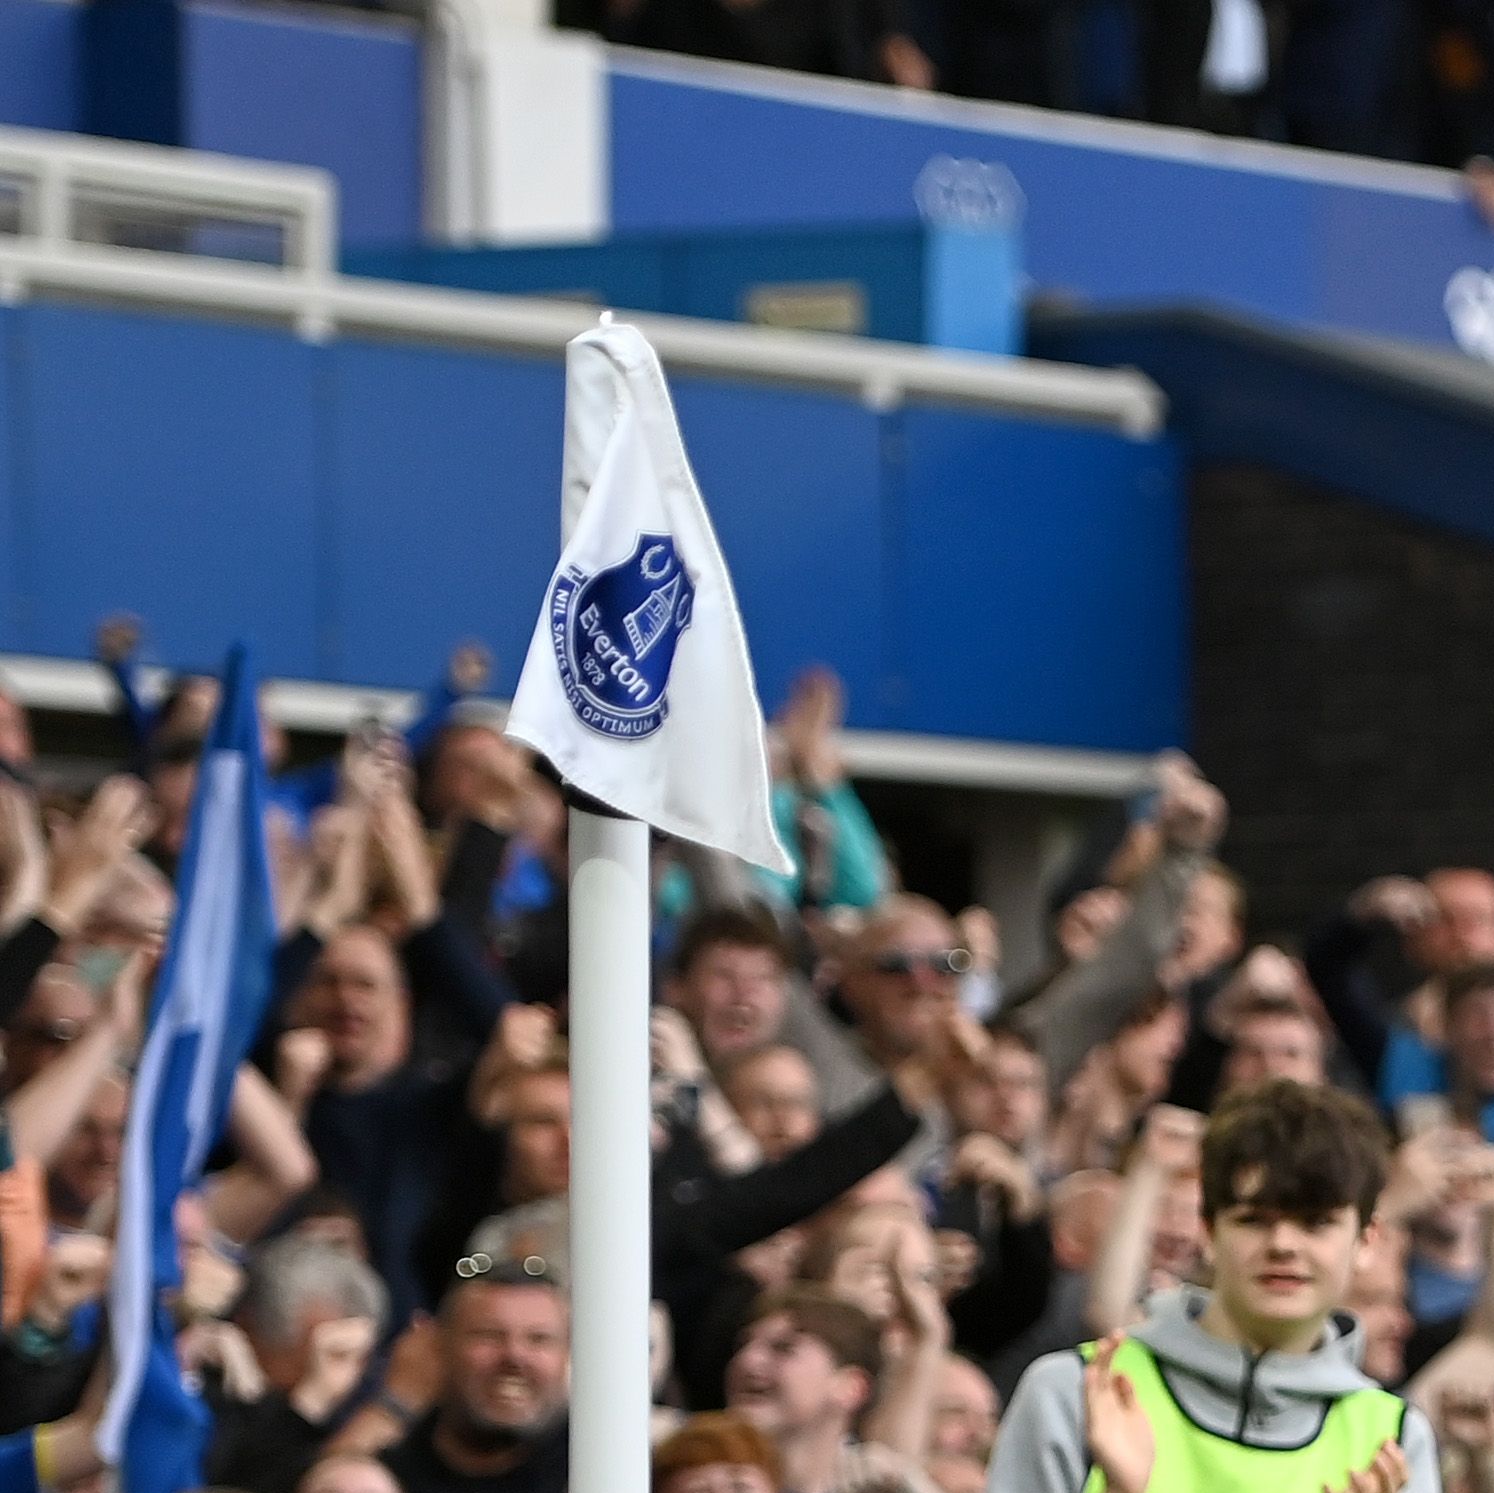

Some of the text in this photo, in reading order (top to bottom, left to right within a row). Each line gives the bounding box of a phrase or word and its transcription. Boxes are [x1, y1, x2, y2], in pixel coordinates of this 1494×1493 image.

[553, 589, 570, 616] NIL
[582, 706, 654, 734] OPTIMUM
[579, 603, 650, 701] Everton
[582, 652, 606, 686] 1878
